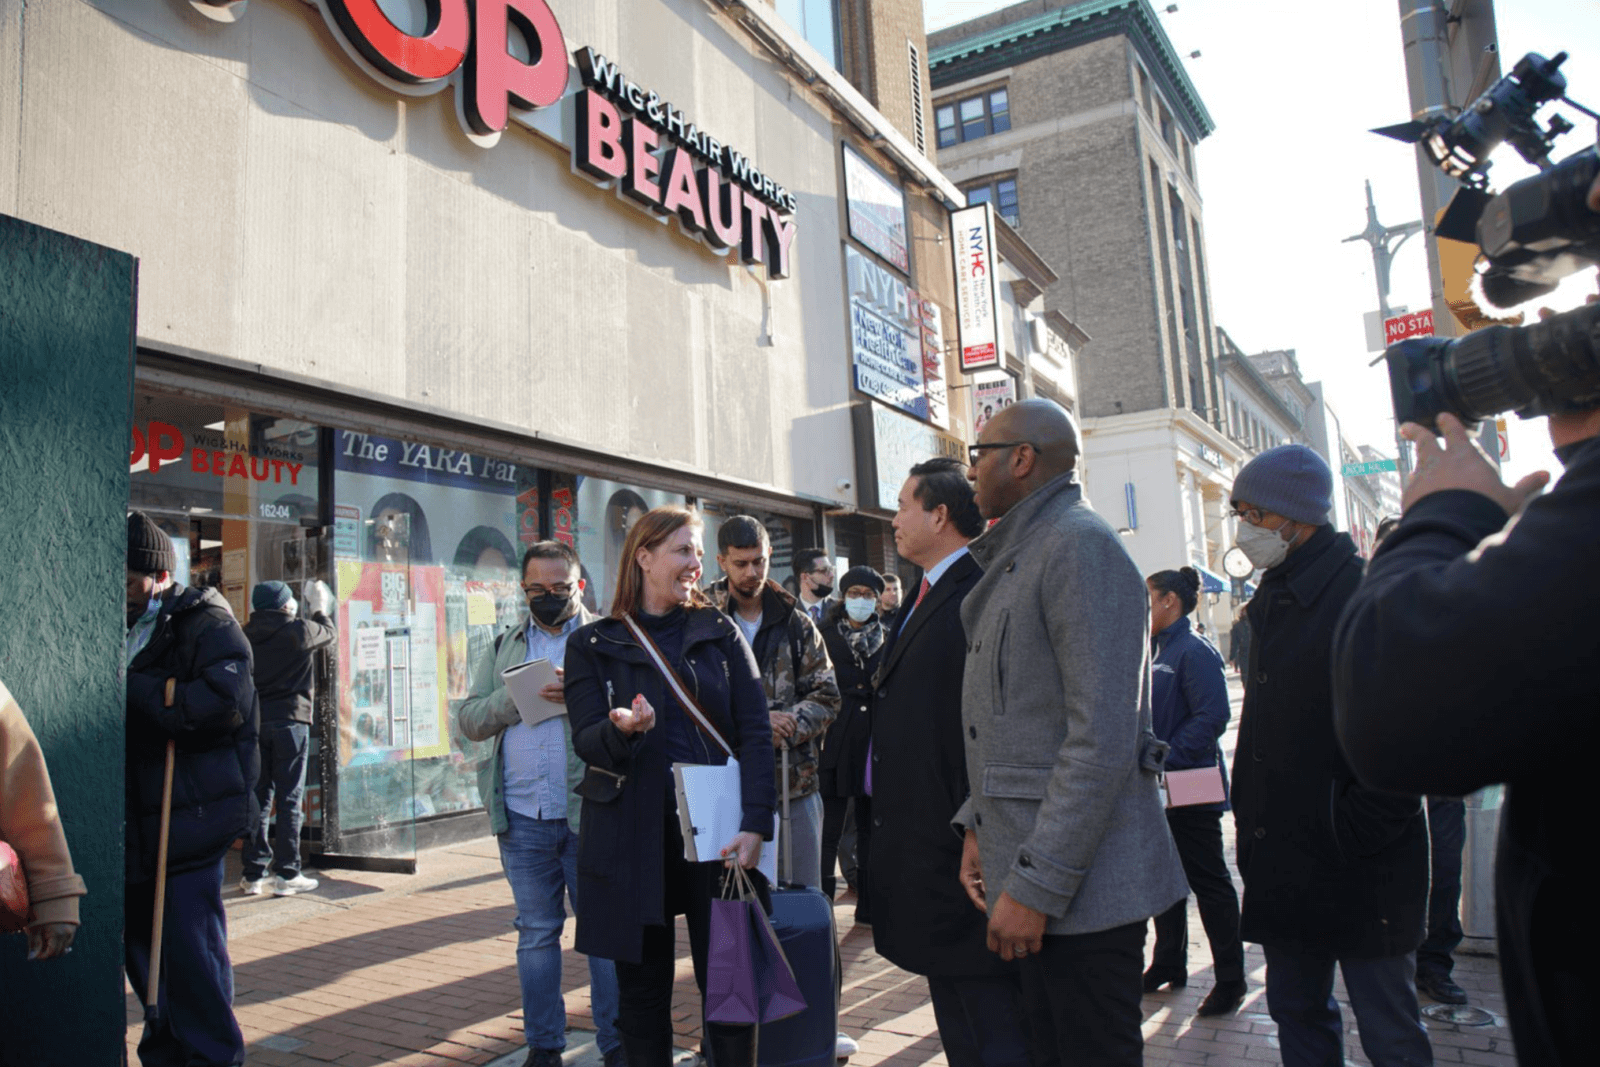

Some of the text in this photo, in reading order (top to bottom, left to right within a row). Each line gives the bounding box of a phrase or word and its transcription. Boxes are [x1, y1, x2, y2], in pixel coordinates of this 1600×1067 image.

[580, 46, 797, 214] WIG&HAIR WORKS
[580, 88, 797, 279] BEAUTY
[969, 226, 985, 278] NYHC
[957, 230, 971, 330] HOME CARE SERVICES
[973, 280, 982, 328] Health Care
[981, 298, 989, 318] York
[1389, 321, 1406, 336] NO
[978, 380, 1007, 391] BEBE
[191, 447, 303, 486] BEAUTY
[263, 446, 304, 461] WORKS
[342, 431, 389, 461] The
[399, 441, 475, 476] YARA
[259, 503, 289, 519] 162-04
[381, 572, 405, 589] BIG
